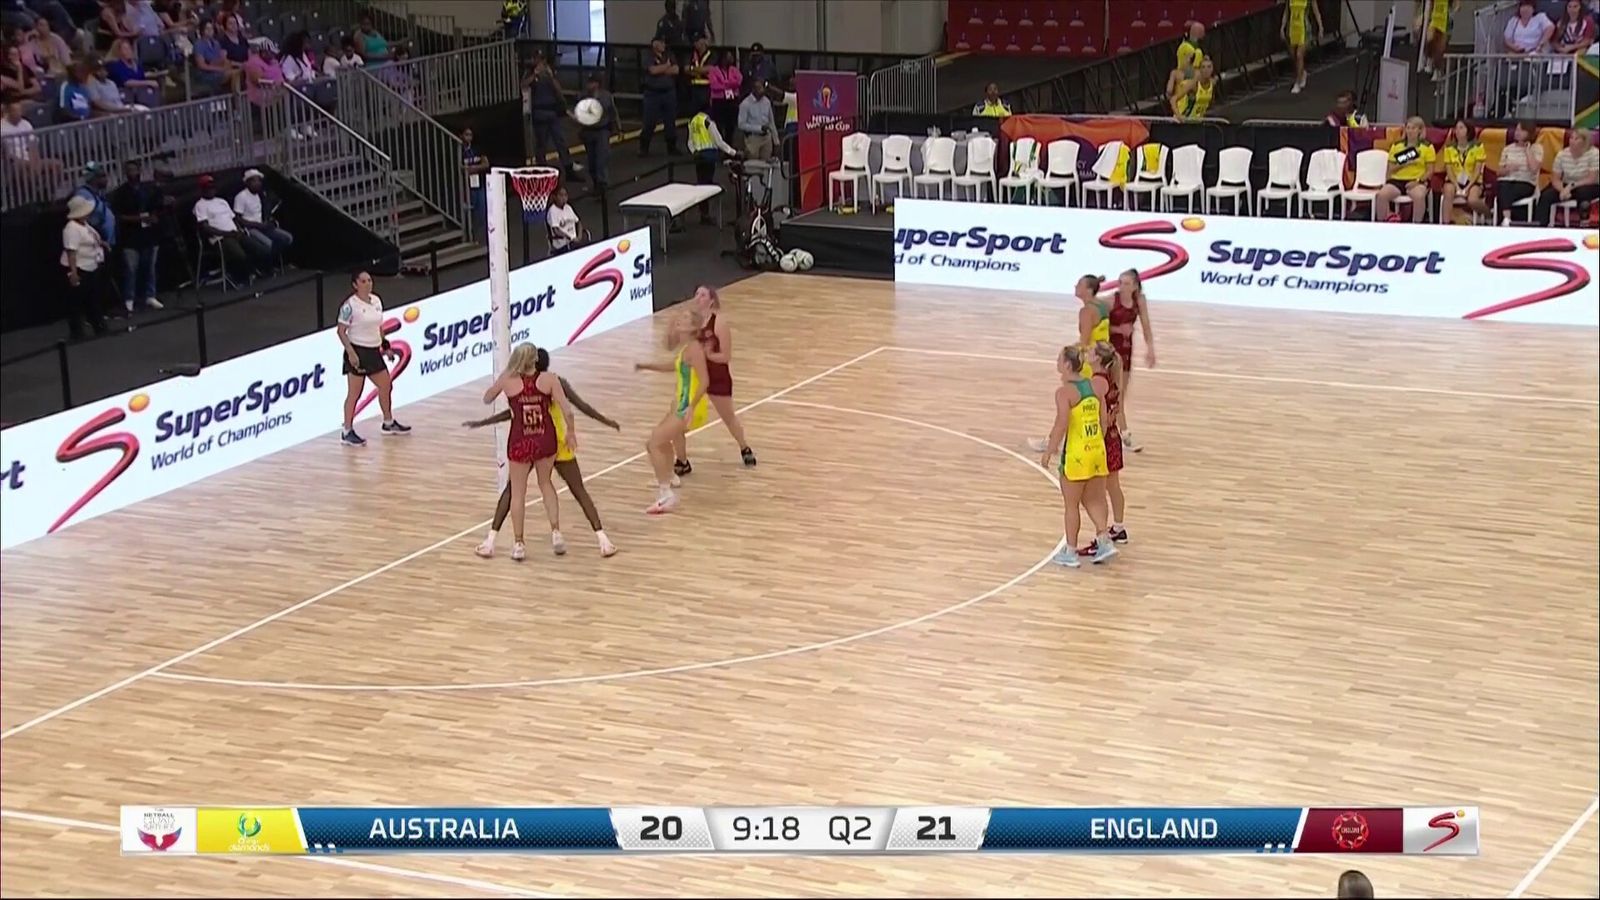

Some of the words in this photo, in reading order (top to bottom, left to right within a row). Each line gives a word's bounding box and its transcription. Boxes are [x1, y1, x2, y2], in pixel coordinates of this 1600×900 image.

[835, 121, 850, 131] CUP
[908, 253, 926, 265] of
[931, 254, 1021, 273] Champions
[1207, 239, 1446, 277] SuperSport
[1200, 271, 1253, 287] World
[1257, 274, 1279, 288] of
[1284, 276, 1389, 294] Champions
[423, 285, 556, 351] Superport
[420, 352, 453, 376] World
[456, 346, 469, 363] of
[471, 327, 530, 357] Chaons
[154, 363, 326, 443] SuperSport
[151, 438, 194, 471] World
[197, 439, 214, 455] of
[217, 410, 293, 449] Champions
[1085, 424, 1099, 437] WD
